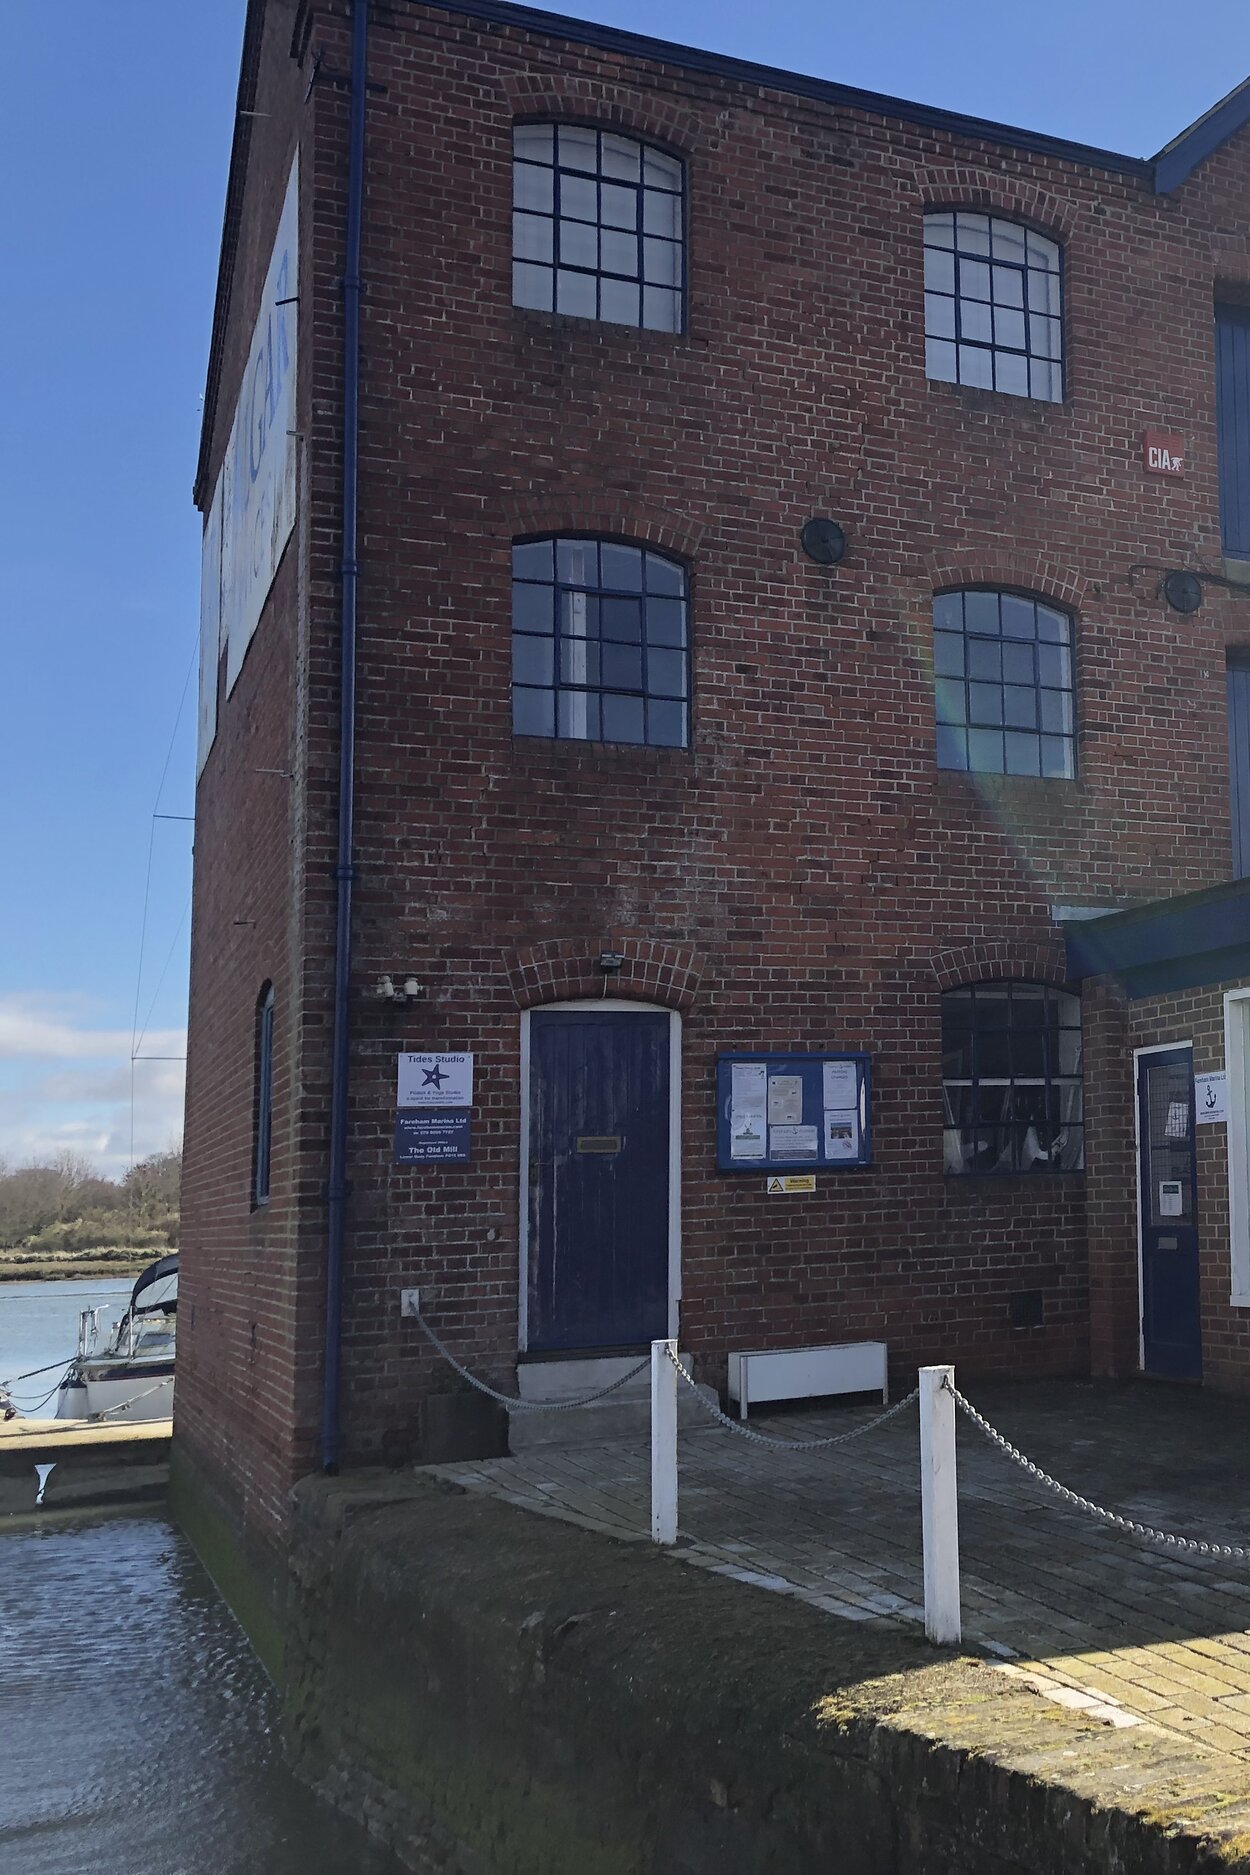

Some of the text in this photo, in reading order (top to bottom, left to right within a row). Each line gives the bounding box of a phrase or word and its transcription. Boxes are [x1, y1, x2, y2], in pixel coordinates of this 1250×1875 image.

[1149, 446, 1171, 470] CIA
[408, 1055, 465, 1063] Tides Studio
